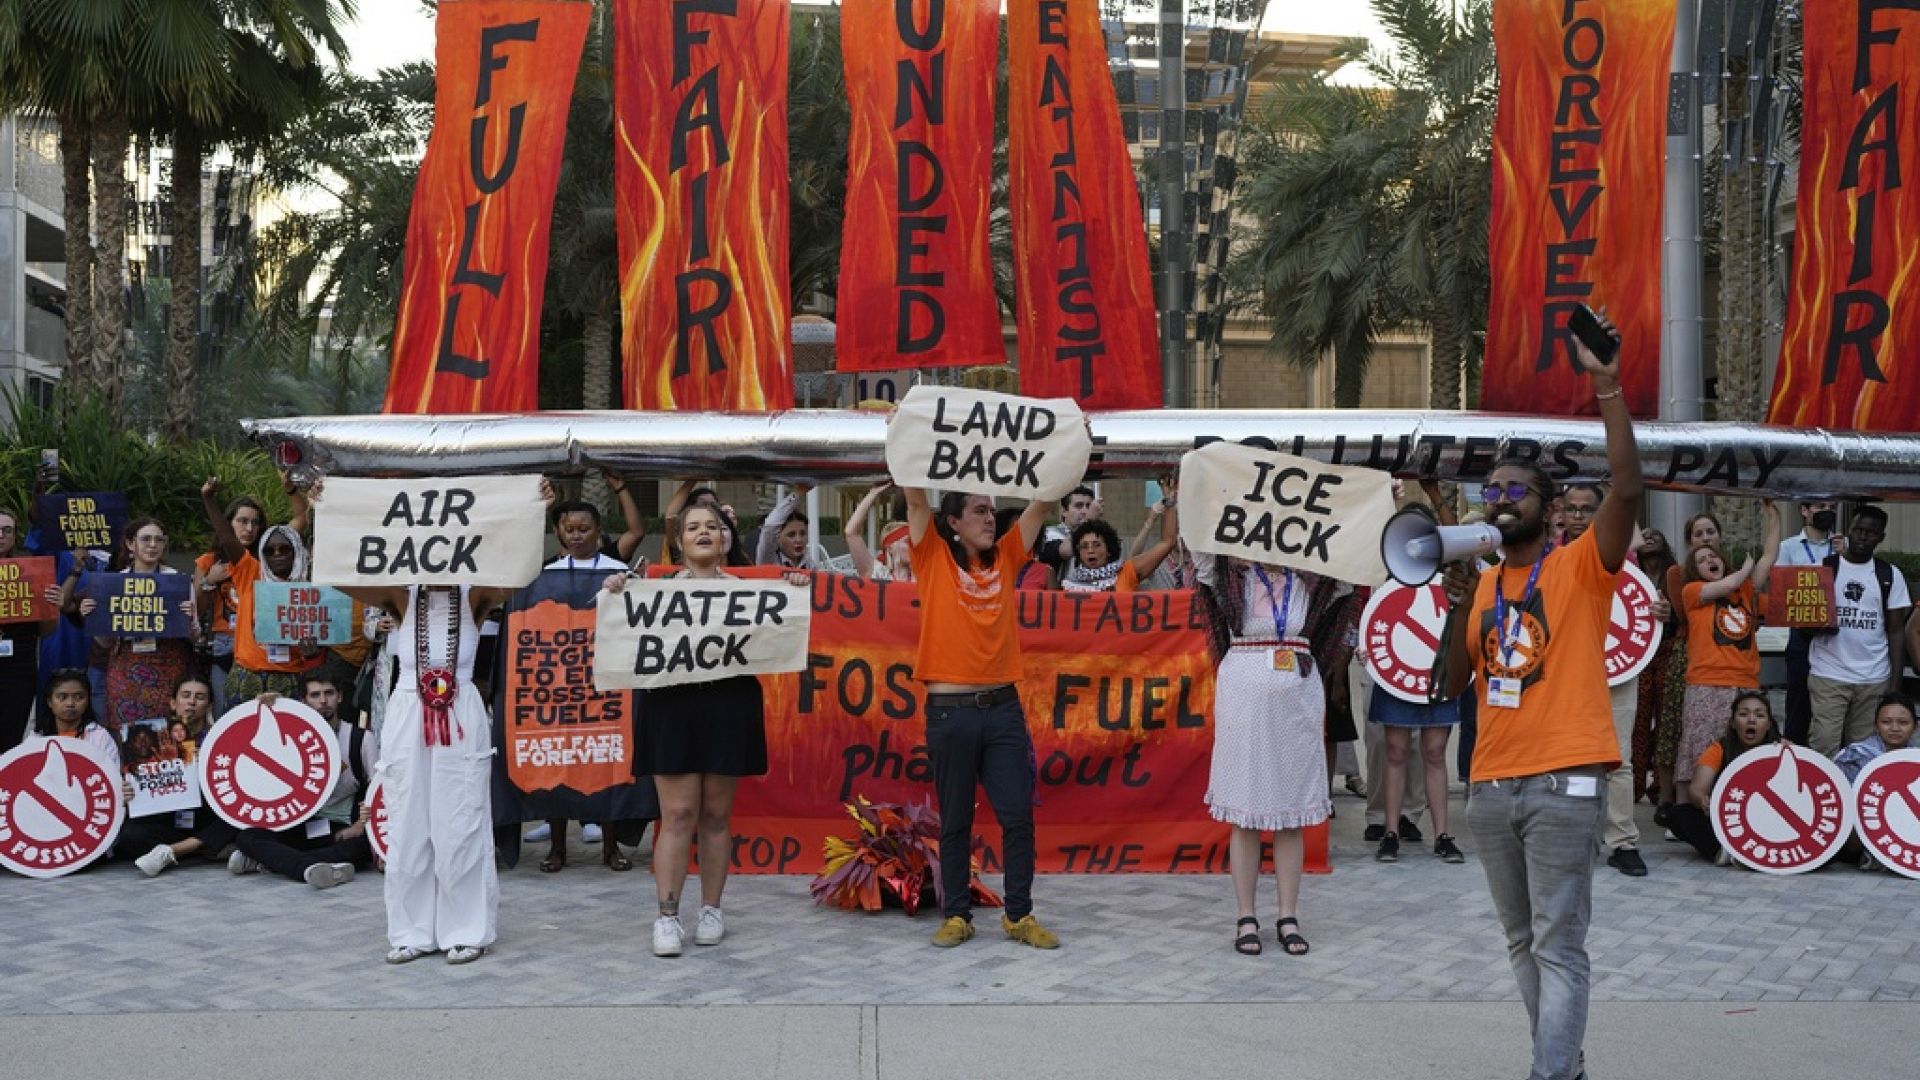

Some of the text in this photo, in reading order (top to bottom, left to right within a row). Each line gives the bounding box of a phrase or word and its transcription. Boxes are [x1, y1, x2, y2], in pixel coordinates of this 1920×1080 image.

[435, 18, 540, 380] FULL
[669, 0, 737, 378] FAIR
[1821, 0, 1920, 386] FAIR
[933, 396, 1056, 442] LAND
[927, 439, 1045, 489] BACK
[1662, 444, 1790, 489] PAY
[67, 498, 96, 513] END
[1243, 461, 1343, 515] ICE
[60, 514, 111, 531] FOSSIL
[383, 488, 474, 527] AIR
[65, 530, 111, 547] FUELS
[1214, 504, 1341, 563] BACK
[356, 534, 482, 574] BACK
[124, 578, 156, 595] END
[290, 588, 321, 605] END
[1787, 589, 1828, 605] FOSSIL
[1798, 571, 1819, 587] END
[110, 597, 168, 614] FOSSIL
[112, 616, 165, 632] FUELS
[277, 604, 333, 623] FOSSIL
[624, 590, 788, 628] WATER
[1621, 582, 1650, 647] FUELS
[1787, 606, 1827, 623] FUELS
[281, 623, 329, 641] FUELS
[634, 634, 752, 675] BACK
[516, 668, 555, 686] TO
[516, 701, 623, 726] FUELS
[516, 733, 623, 752] FAST FAIR
[516, 748, 624, 768] FOREVER
[238, 798, 308, 823] FOSSIL
[299, 729, 326, 795] FUELS
[1041, 742, 1152, 788] out
[11, 840, 87, 864] FOSSIL
[84, 773, 111, 840] FUELS
[1742, 837, 1812, 865] FOSSIL
[1811, 782, 1839, 848] FUELS
